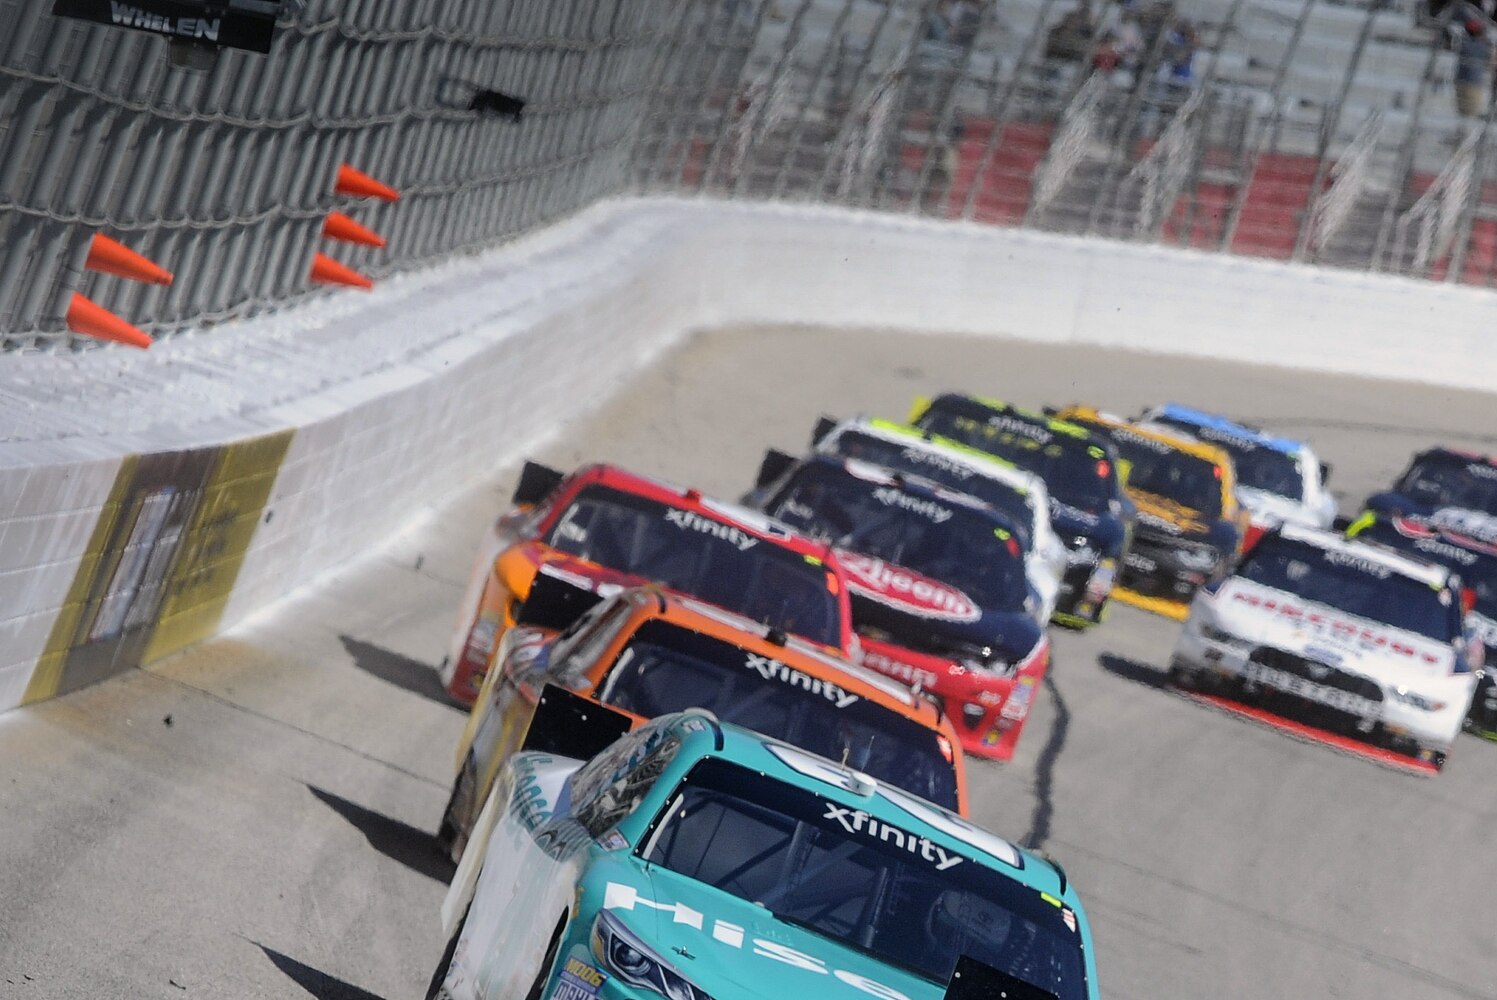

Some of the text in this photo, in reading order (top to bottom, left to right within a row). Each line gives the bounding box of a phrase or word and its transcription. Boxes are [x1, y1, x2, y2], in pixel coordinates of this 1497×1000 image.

[110, 1, 220, 41] WHELEN
[665, 507, 760, 551] xfinity
[745, 652, 859, 708] xfinity
[823, 802, 964, 871] xfinity
